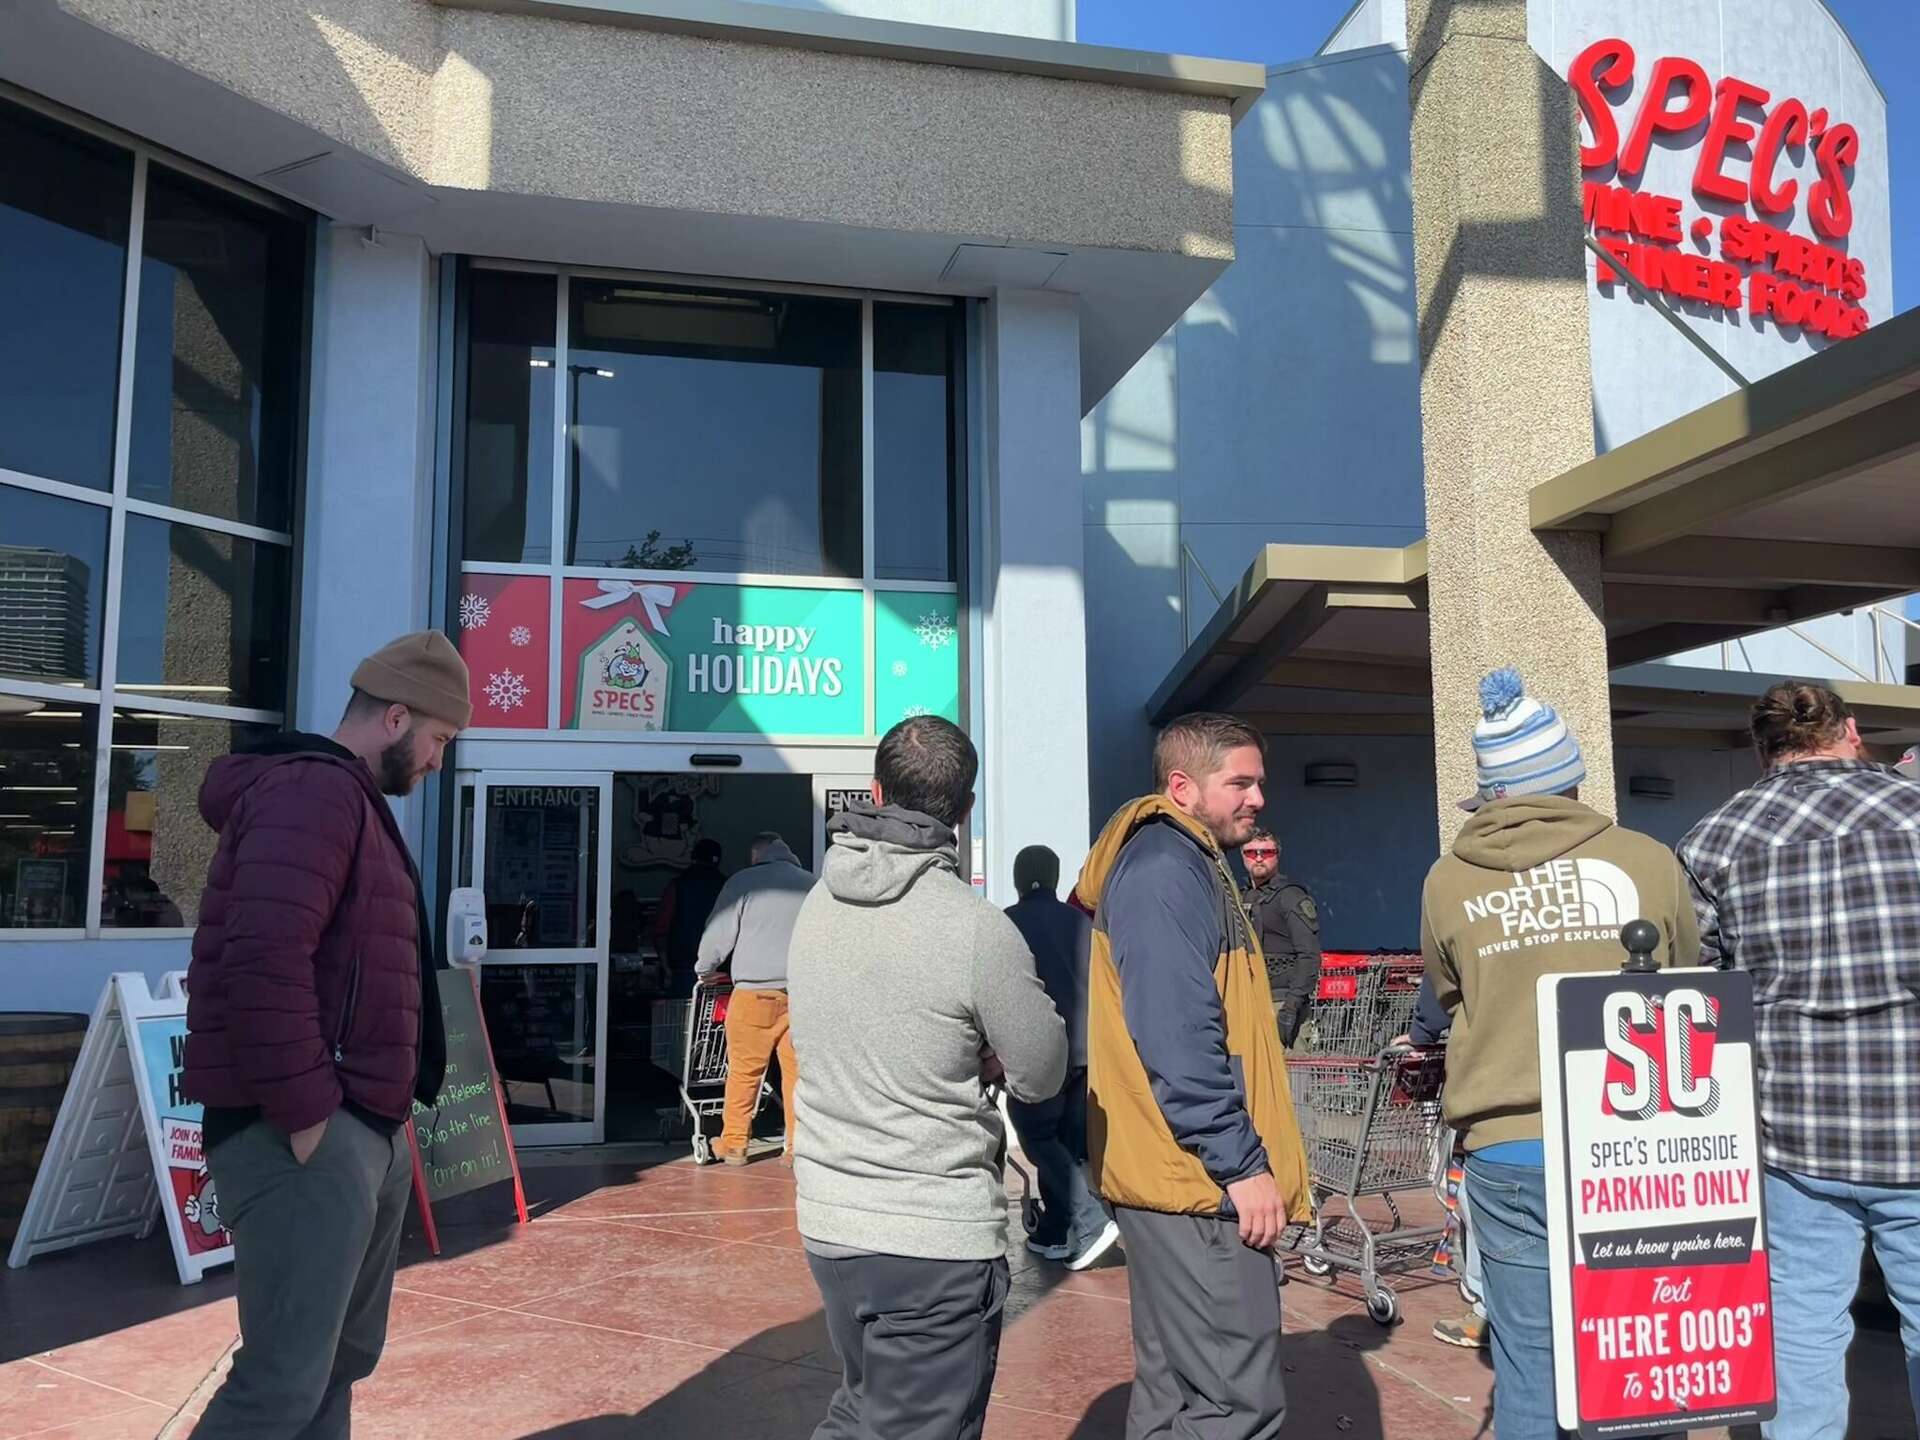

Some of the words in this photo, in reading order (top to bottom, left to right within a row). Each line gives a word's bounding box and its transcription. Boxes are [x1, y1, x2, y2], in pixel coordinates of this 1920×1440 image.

[1568, 38, 1859, 239] SPEC'S
[1720, 214, 1867, 301] SPIRITS
[1596, 239, 1743, 310] FINER
[1749, 272, 1870, 339] FOODS
[712, 617, 816, 654] happy
[688, 653, 843, 697] HOLIDAYS
[593, 689, 655, 712] SPEC'S
[494, 787, 596, 807] ENTRANCE
[1463, 880, 1581, 923] NORTH
[1500, 903, 1583, 937] FACE
[1478, 939, 1520, 958] NEVER
[1524, 933, 1559, 946] STOP
[1564, 929, 1620, 942] EXPLOR
[1603, 988, 1719, 1121] SC
[169, 1126, 190, 1142] JOIN
[416, 1126, 448, 1149] Skip
[449, 1119, 468, 1136] the
[469, 1112, 491, 1130] line
[1591, 1136, 1648, 1168] SPEC'S
[1656, 1134, 1738, 1164] CURBSIDE
[1581, 1172, 1686, 1215] PARKING
[1694, 1168, 1751, 1206] ONLY
[1592, 1242, 1614, 1258] Let
[1615, 1244, 1632, 1256] us
[1635, 1238, 1670, 1255] know
[1671, 1234, 1712, 1260] you're
[1713, 1231, 1746, 1250] here.
[1652, 1276, 1692, 1304] Text
[1581, 1312, 1671, 1361] “HERE
[1679, 1303, 1766, 1352] 0003”
[1623, 1372, 1643, 1400] To
[1650, 1359, 1731, 1401] 313313
